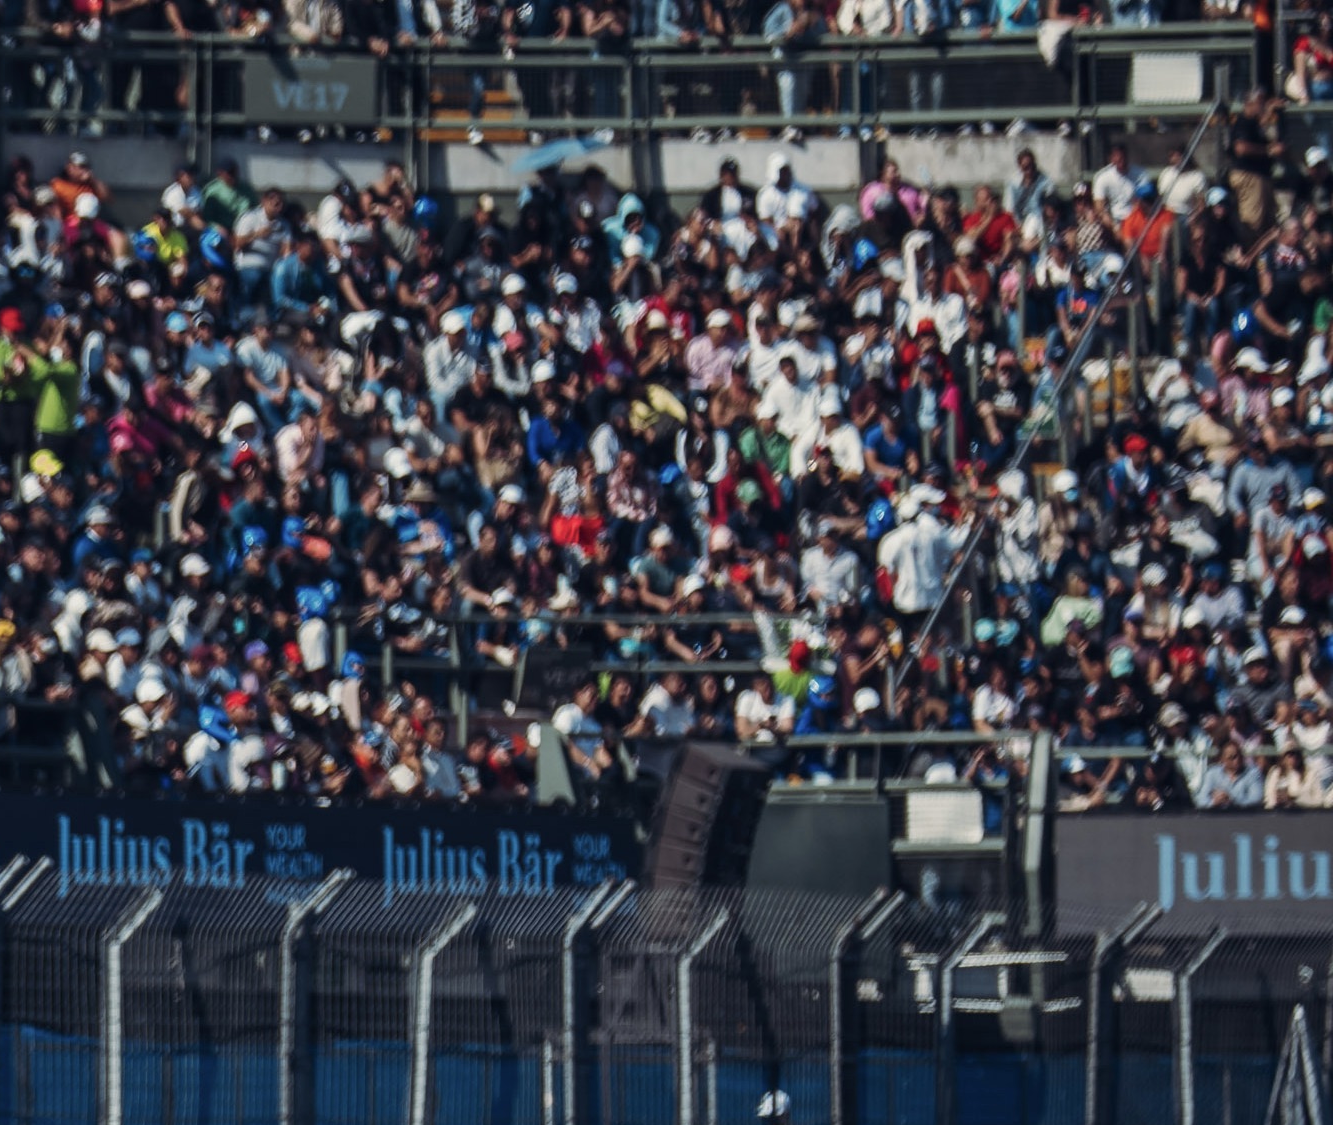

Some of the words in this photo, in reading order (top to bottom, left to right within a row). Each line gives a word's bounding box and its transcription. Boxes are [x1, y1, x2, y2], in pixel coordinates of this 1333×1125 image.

[56, 813, 172, 899] Julius
[181, 817, 254, 889] Bär
[264, 822, 306, 851] YOUR
[382, 824, 486, 909] Julius
[496, 827, 563, 897] Bär
